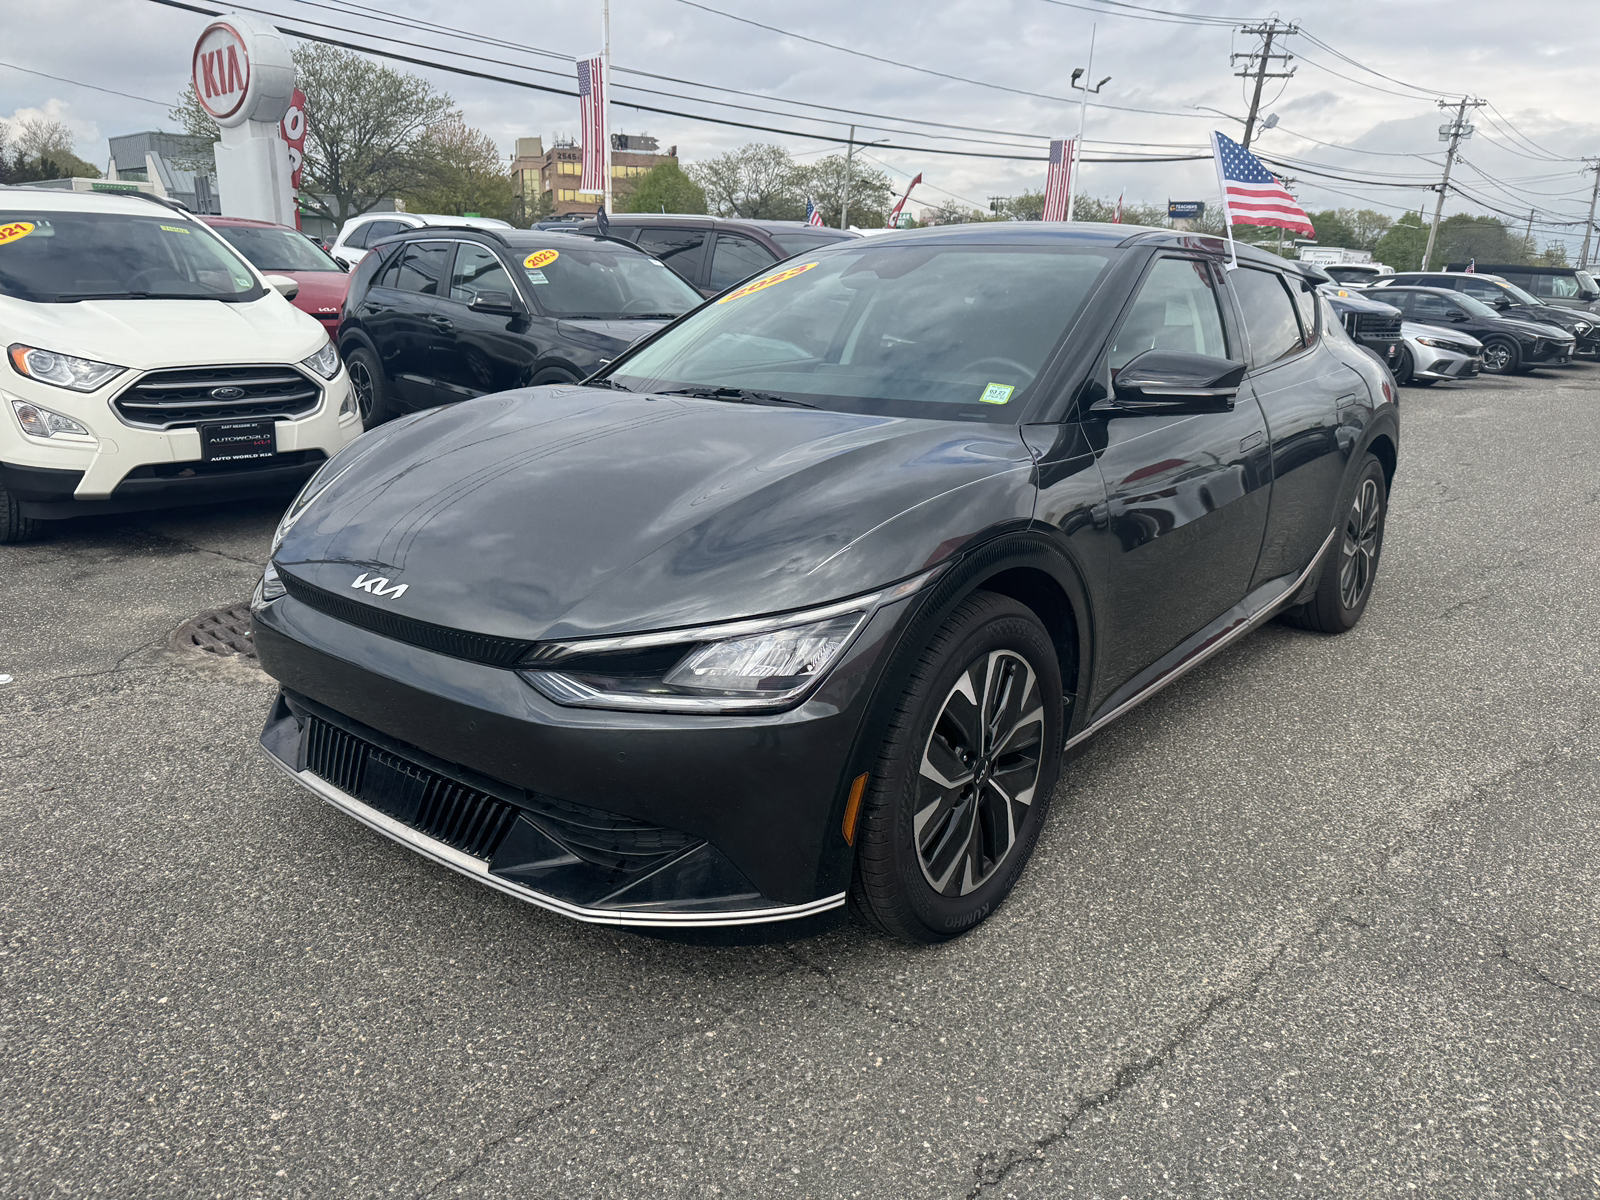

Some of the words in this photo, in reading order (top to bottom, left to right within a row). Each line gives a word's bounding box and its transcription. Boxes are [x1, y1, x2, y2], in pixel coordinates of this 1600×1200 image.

[200, 44, 245, 98] KIA
[527, 250, 556, 267] 2023
[726, 265, 807, 301] 2023
[944, 902, 990, 928] KUMHO
